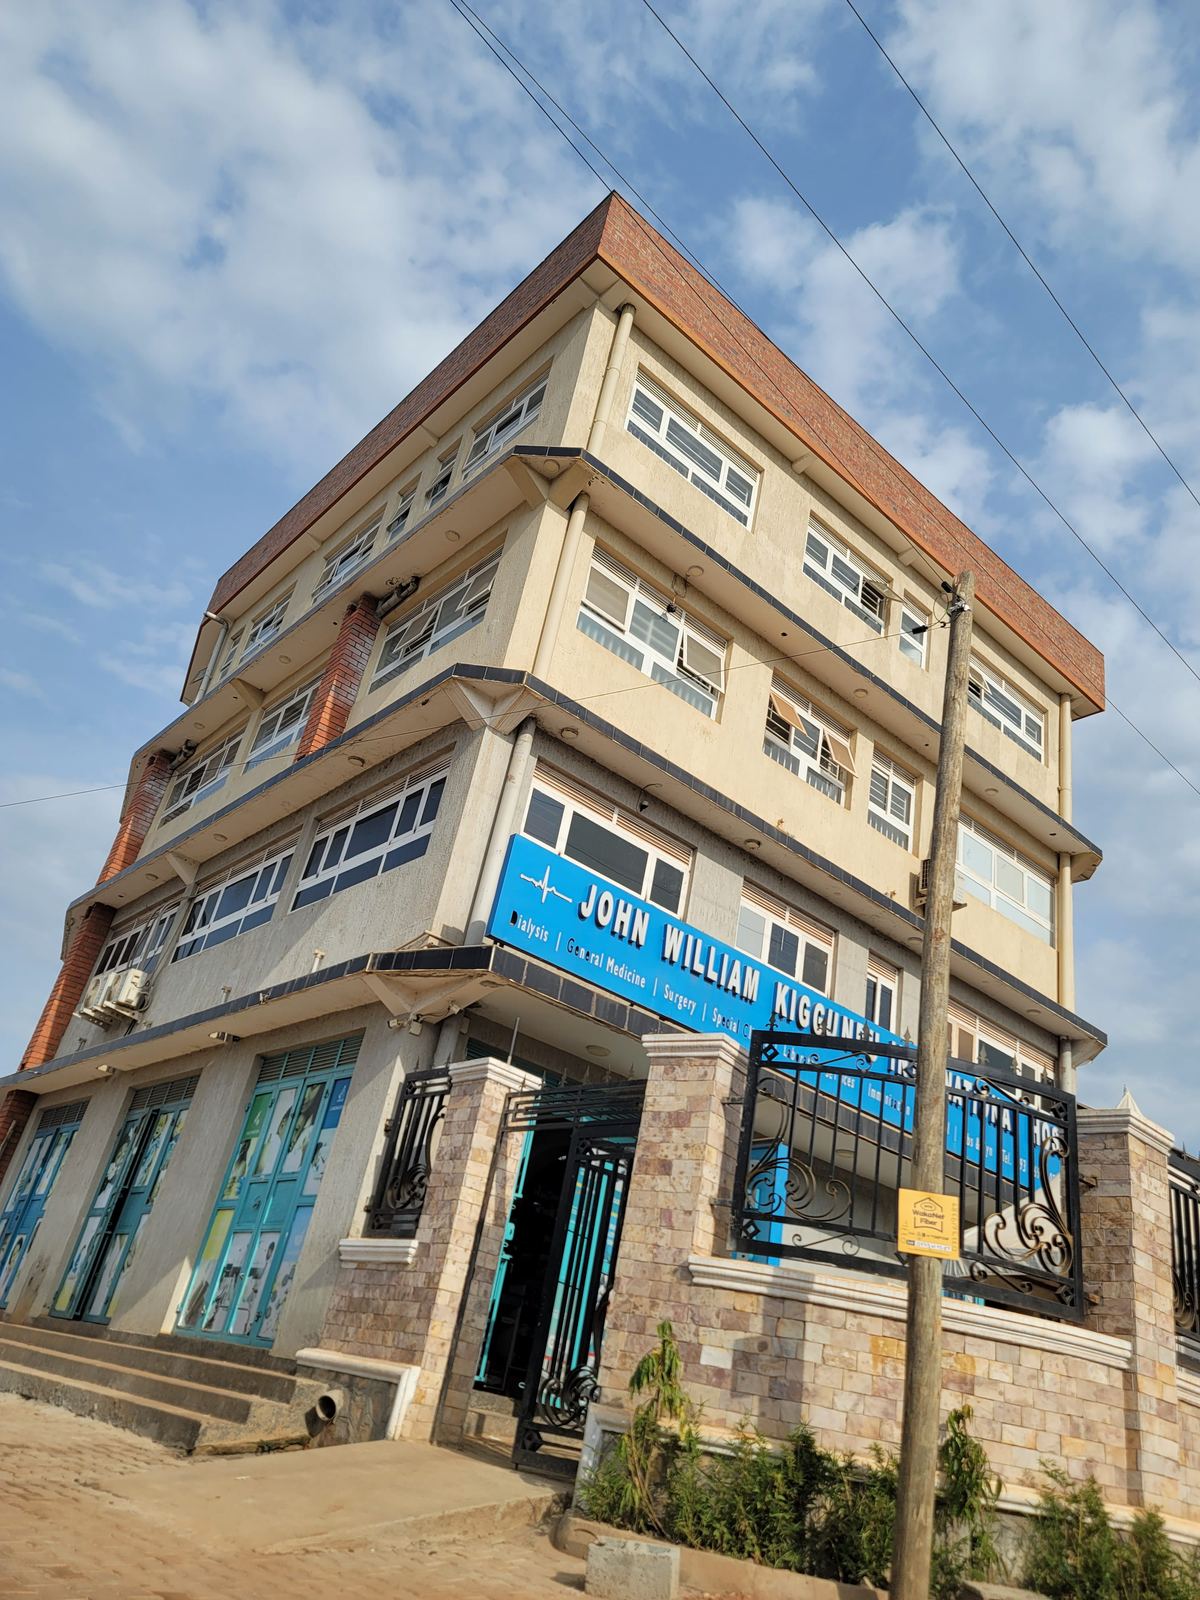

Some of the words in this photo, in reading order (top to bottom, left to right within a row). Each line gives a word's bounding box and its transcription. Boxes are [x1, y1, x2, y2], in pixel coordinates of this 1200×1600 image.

[509, 910, 549, 942] Dialysis
[567, 938, 604, 968] General
[605, 956, 646, 988] Medicine
[663, 984, 697, 1016] Surgery
[712, 1008, 740, 1034] Special
[579, 884, 650, 948] JOHN
[663, 923, 761, 1003] WILLIAM
